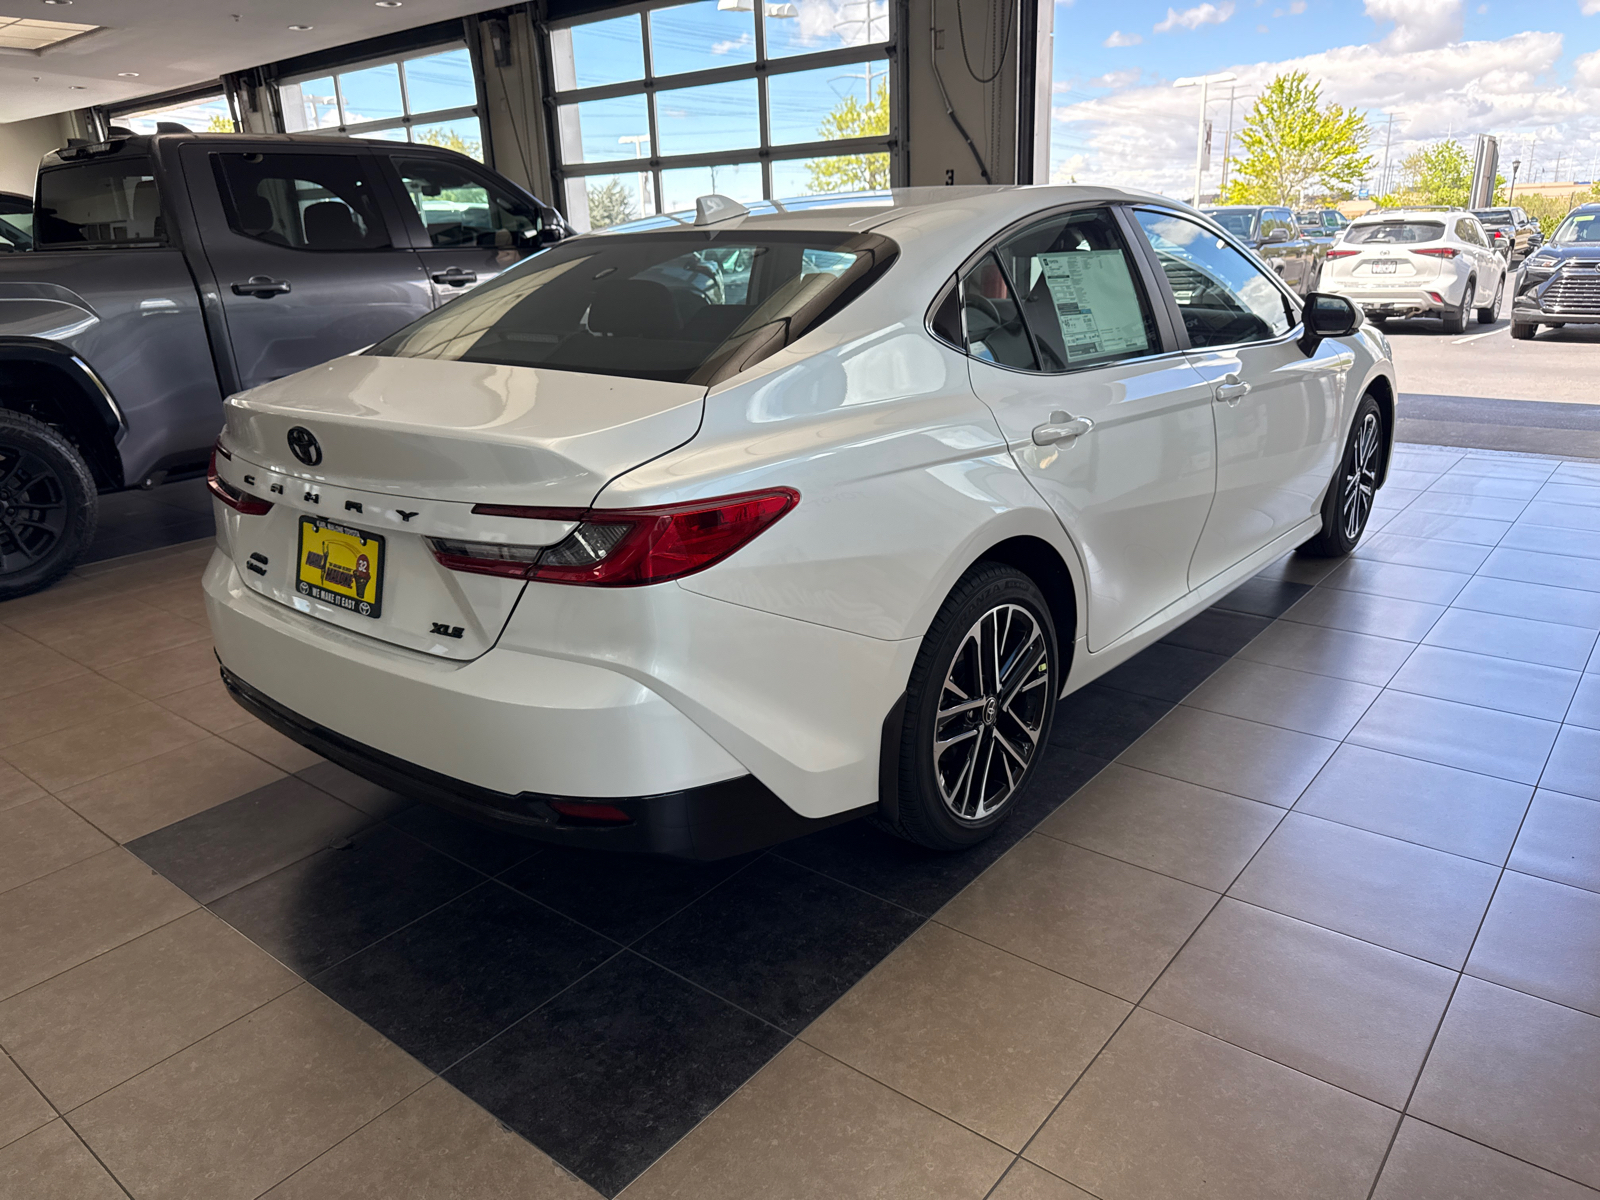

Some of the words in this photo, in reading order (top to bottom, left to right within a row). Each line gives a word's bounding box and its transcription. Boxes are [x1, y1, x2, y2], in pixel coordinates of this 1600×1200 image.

[945, 169, 954, 186] 3
[244, 474, 419, 522] CAMRY
[358, 560, 368, 572] 32
[312, 586, 320, 598] WE
[320, 589, 335, 603] MAKE
[335, 595, 341, 605] IT
[429, 621, 465, 639] XLE
